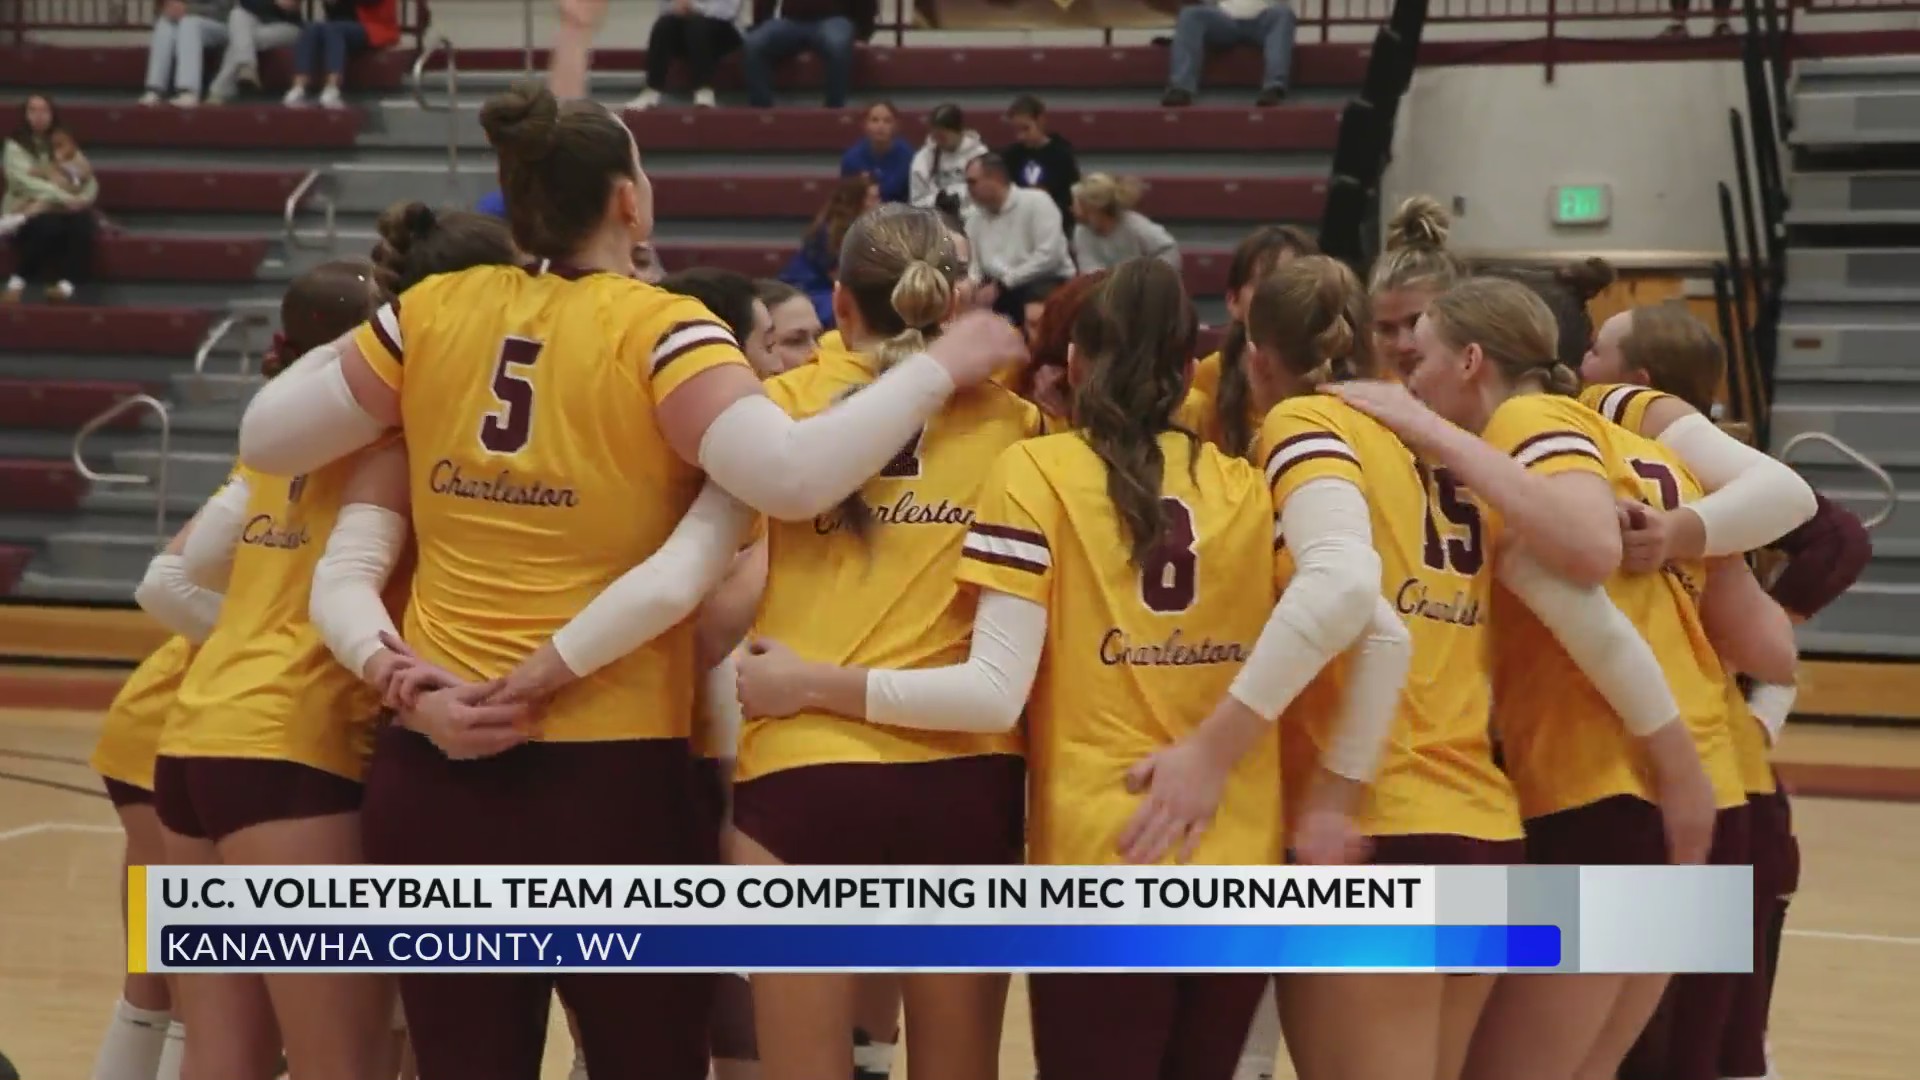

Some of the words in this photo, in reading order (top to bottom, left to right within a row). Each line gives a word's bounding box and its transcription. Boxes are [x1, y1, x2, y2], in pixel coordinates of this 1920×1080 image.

[478, 335, 545, 455] 5
[429, 459, 579, 508] Charleston
[813, 490, 977, 535] Crleston
[1421, 465, 1486, 578] 15
[1138, 495, 1200, 616] 8
[1100, 628, 1249, 666] Charleston
